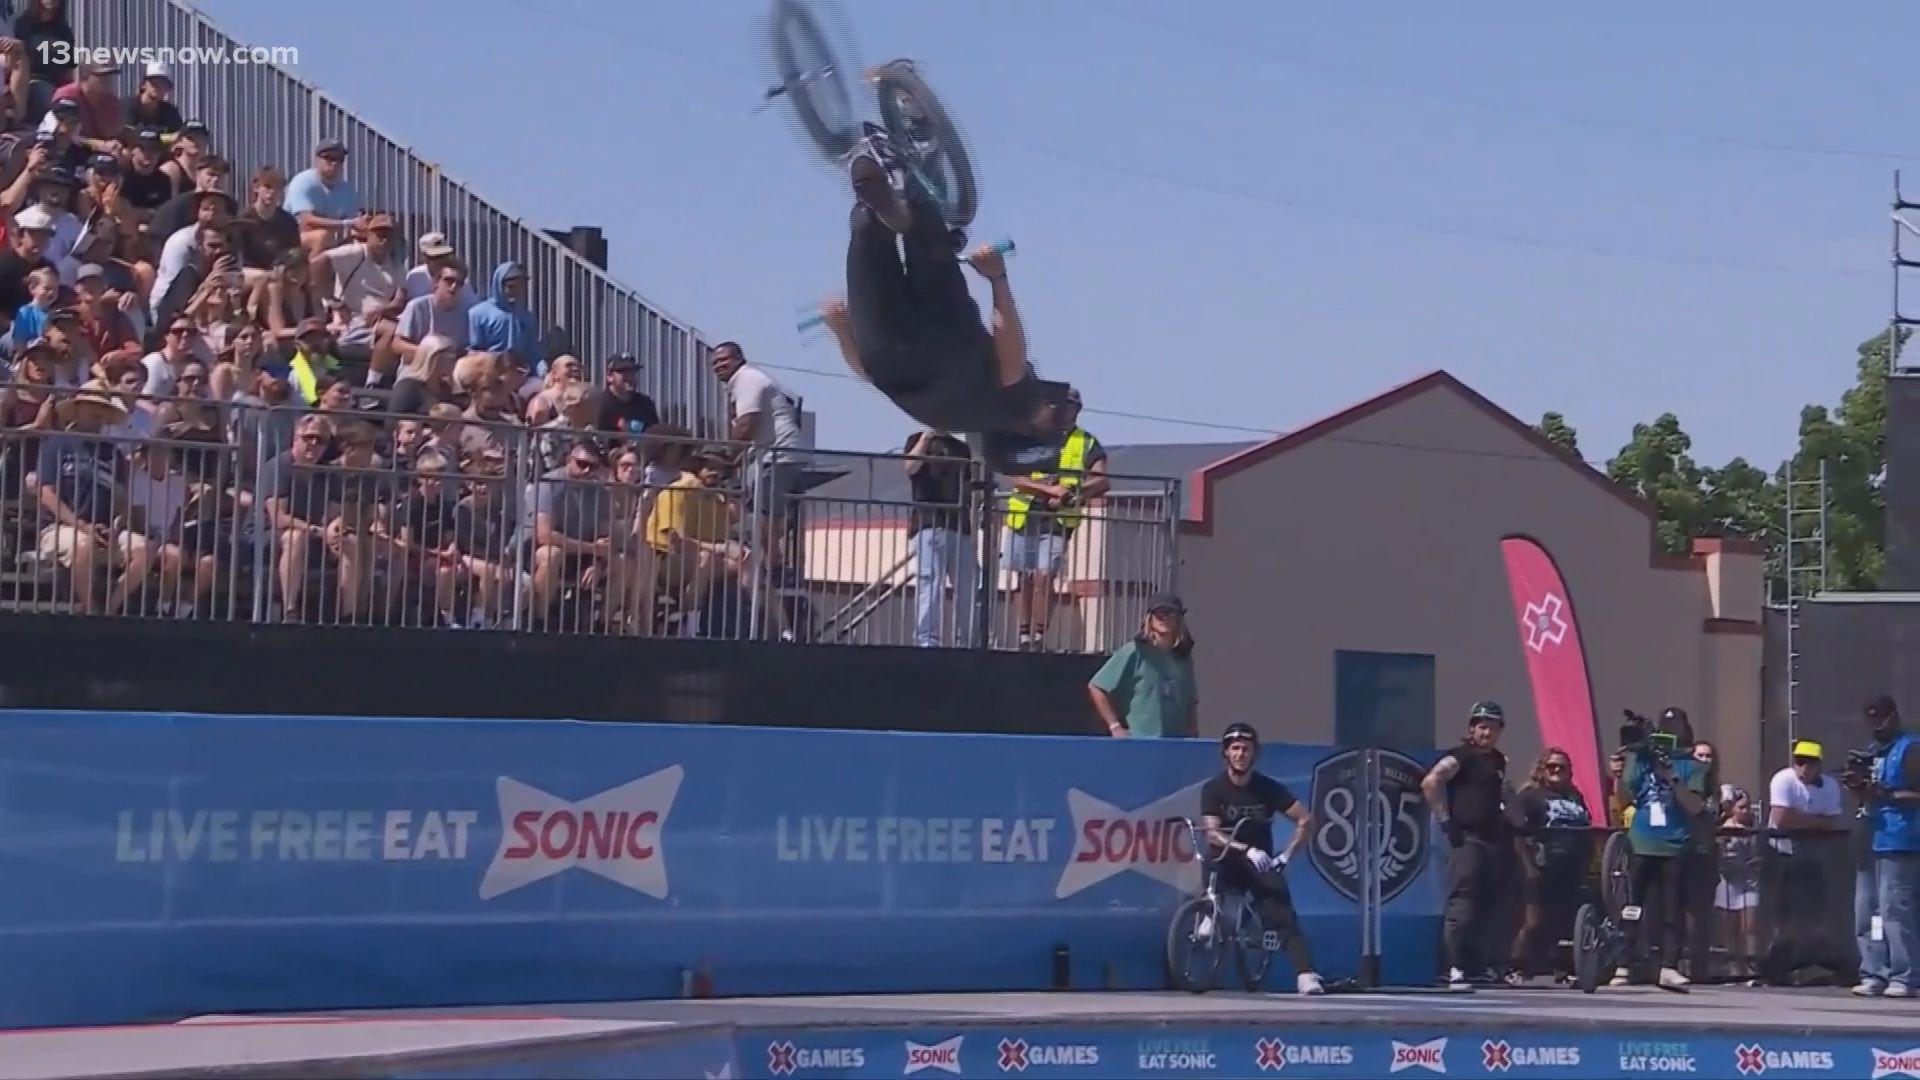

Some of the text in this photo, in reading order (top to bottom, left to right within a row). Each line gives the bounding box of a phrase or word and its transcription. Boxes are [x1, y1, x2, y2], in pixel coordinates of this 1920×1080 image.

[116, 809, 478, 862] LIVE FREE EAT
[503, 811, 658, 859] SONIC
[777, 816, 1055, 863] LIVE FREE EAT
[1076, 819, 1196, 863] SONIC
[797, 1047, 865, 1067] GAMES
[911, 1048, 956, 1064] SONIC
[1029, 1045, 1099, 1065] GAMES
[1139, 1053, 1217, 1069] EAT SONIC
[1286, 1045, 1353, 1064] GAMES
[1396, 1048, 1441, 1063] SONIC
[1512, 1047, 1580, 1065] GAMES
[1766, 1051, 1834, 1069] GAMES
[1878, 1056, 1920, 1070] SONIC
[1620, 1056, 1697, 1072] EAT SONIC
